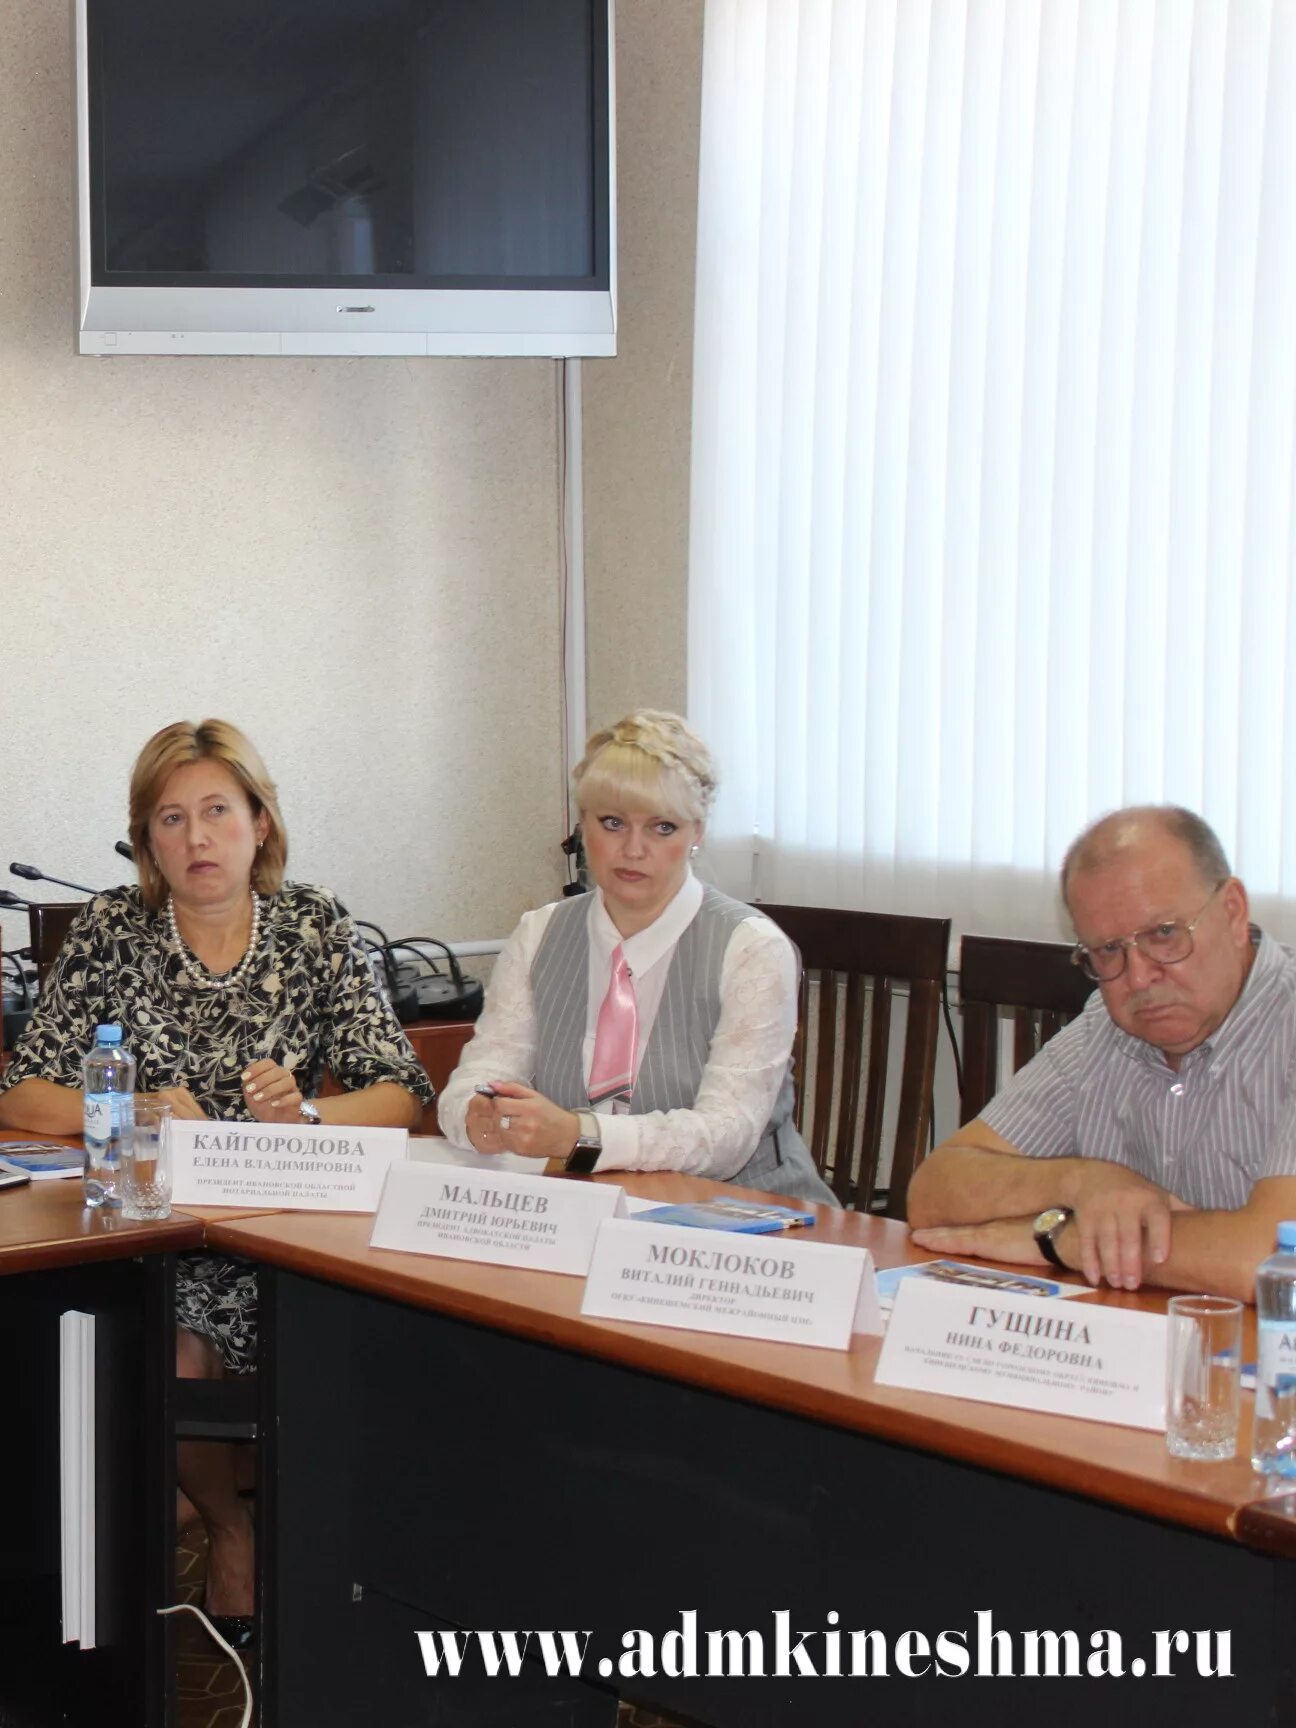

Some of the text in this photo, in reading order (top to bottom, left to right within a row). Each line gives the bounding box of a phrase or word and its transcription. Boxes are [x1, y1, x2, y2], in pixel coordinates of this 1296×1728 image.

[194, 1132, 366, 1156] КАЙГОРОДОВА
[192, 1156, 364, 1174] ЕЛЕНА ВЛАДИМИРОВНА
[440, 1184, 550, 1214] МАЛЬЦЕВ
[420, 1206, 559, 1235] ДМИТРИЙ ЮРЬЕВИЧ
[646, 1244, 796, 1280] МОКЛОКОВ
[621, 1268, 815, 1304] ВИТАЛИЙ ГЕННАДЬЕВИЧ
[968, 1306, 1092, 1345] ГУЩИНА
[946, 1332, 993, 1351] НИНА
[998, 1339, 1104, 1370] ФЕДОРОВНА
